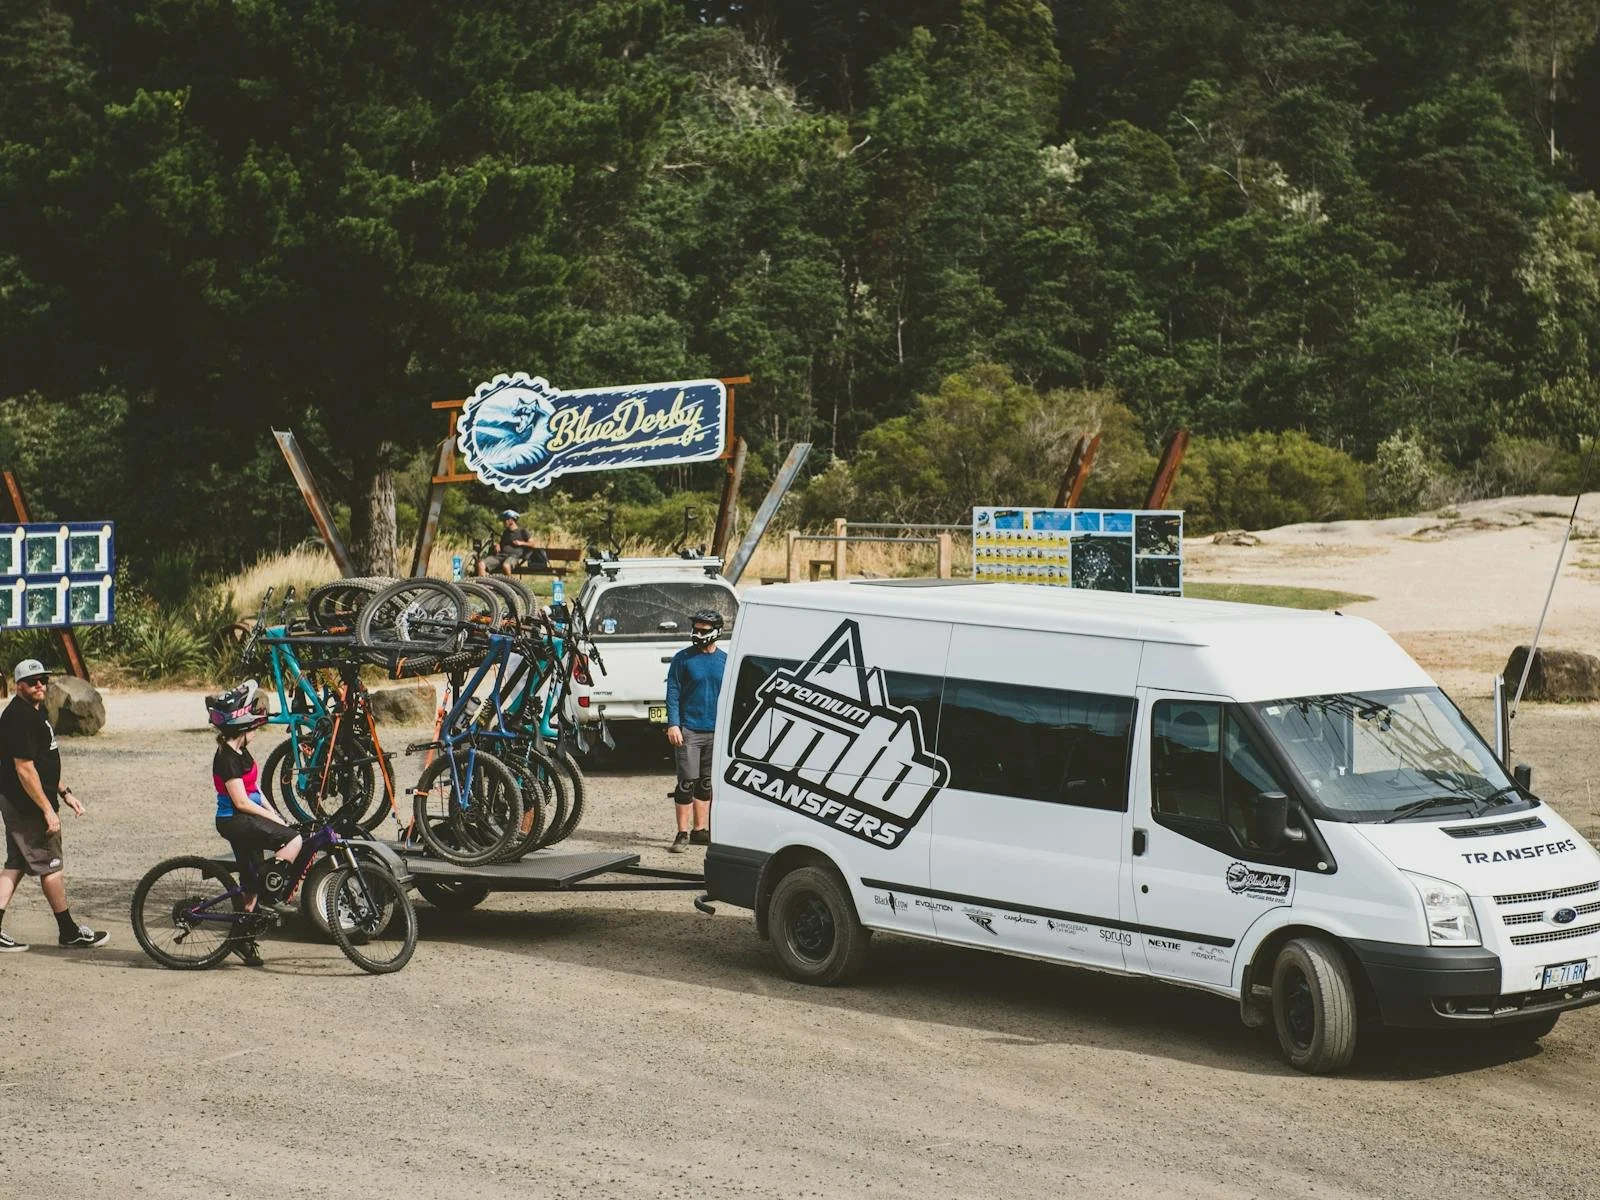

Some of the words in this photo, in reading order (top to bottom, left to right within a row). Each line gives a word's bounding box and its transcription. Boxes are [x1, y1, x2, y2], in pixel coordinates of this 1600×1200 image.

[731, 762, 904, 845] TRANSFERS
[1461, 839, 1577, 864] TRANSFERS
[915, 900, 953, 912] EVOLUTION
[1099, 929, 1132, 946] sprung
[1148, 939, 1181, 951] NEXTIE
